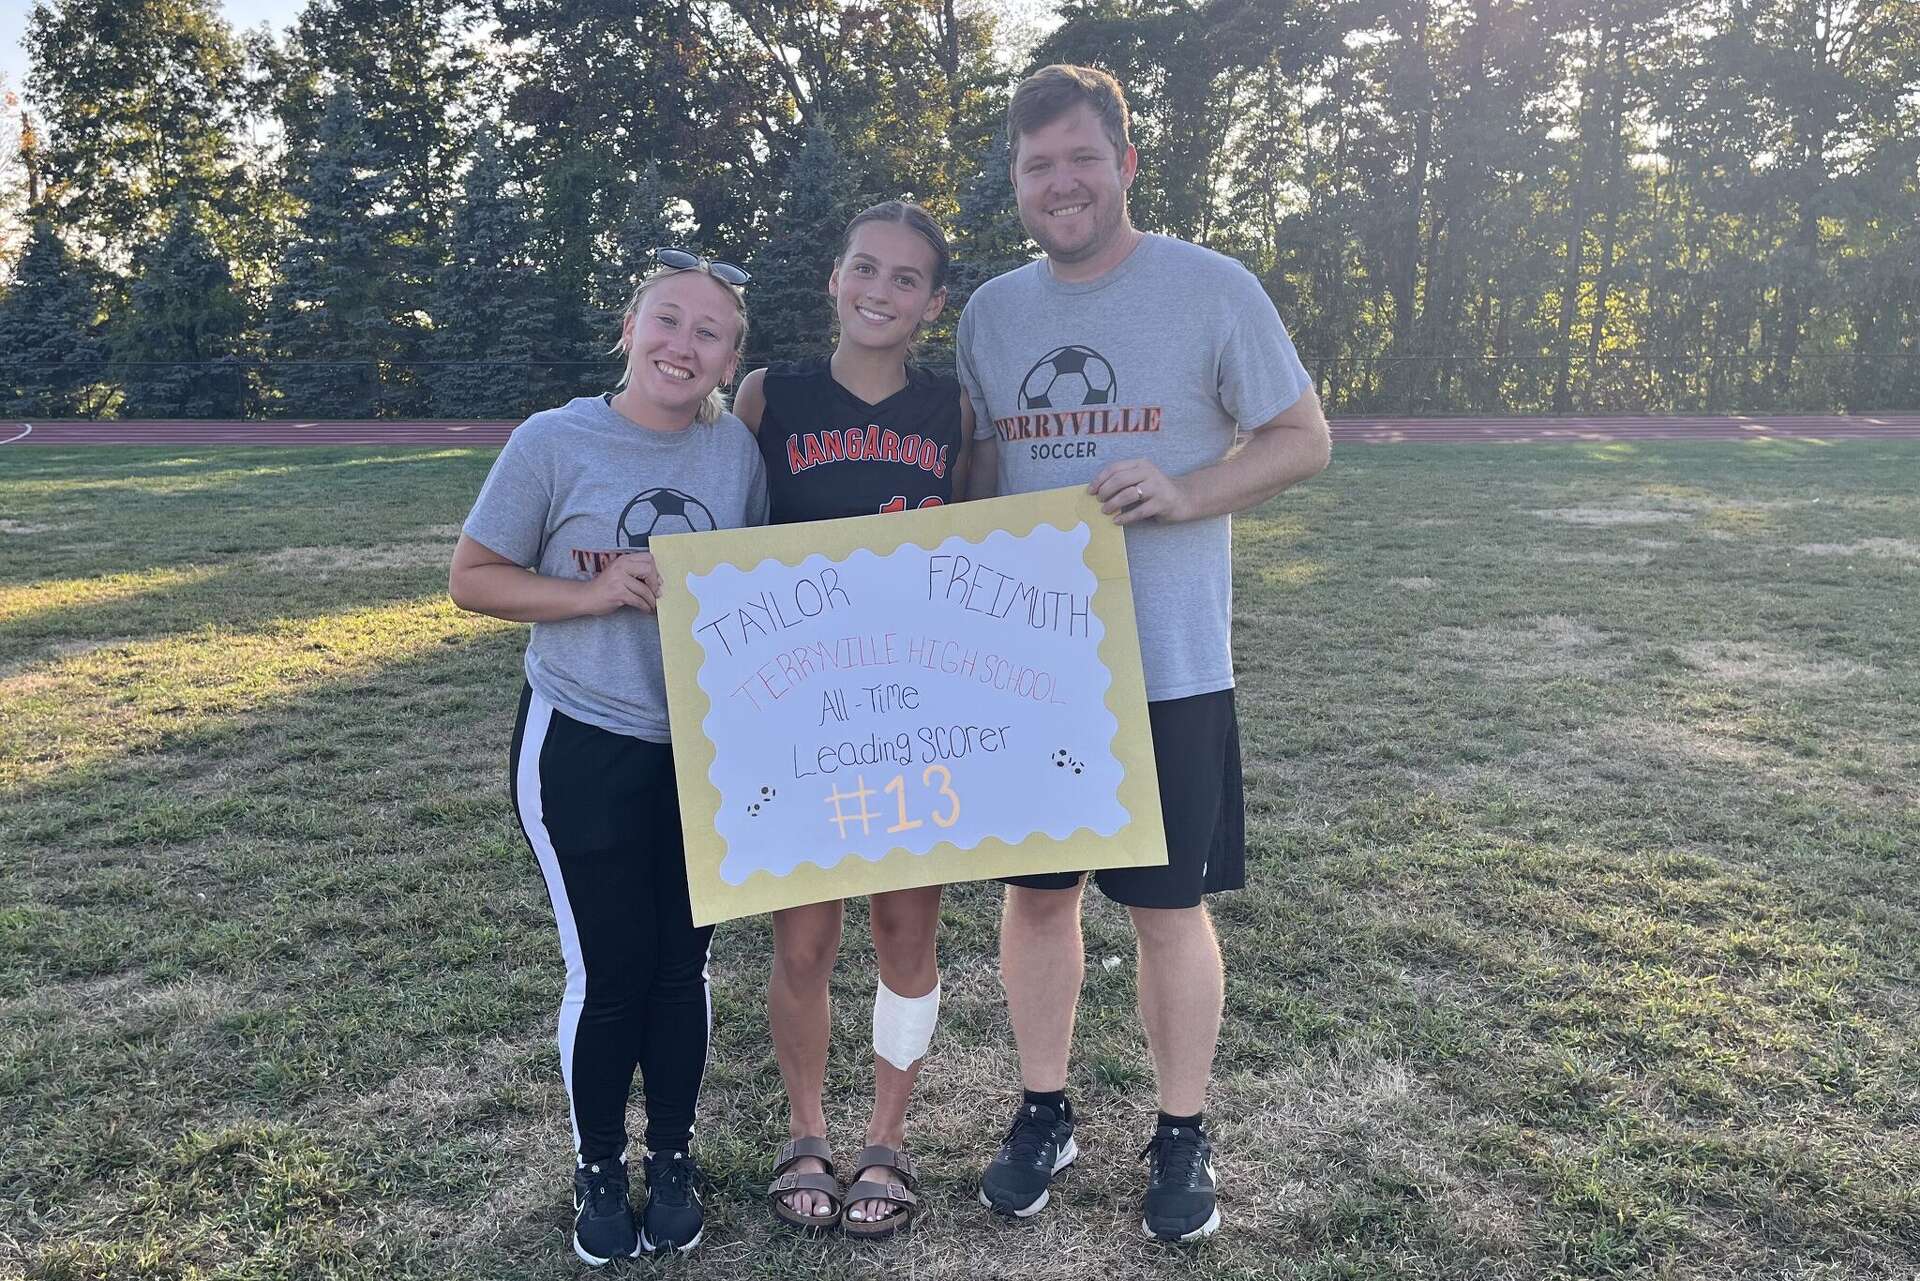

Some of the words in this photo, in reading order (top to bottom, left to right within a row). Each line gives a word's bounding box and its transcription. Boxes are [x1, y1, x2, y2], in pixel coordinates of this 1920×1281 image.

[786, 424, 948, 478] KANGAROOS
[1031, 442, 1097, 460] SOCCER
[697, 567, 851, 657] TAYLOR
[928, 555, 1089, 638] FREIMUTH
[729, 632, 900, 713] TERRYVILLE
[908, 636, 979, 679] HIGH
[979, 654, 1067, 705] SCHOOL
[793, 732, 913, 779] Leading
[823, 763, 961, 840] #13
